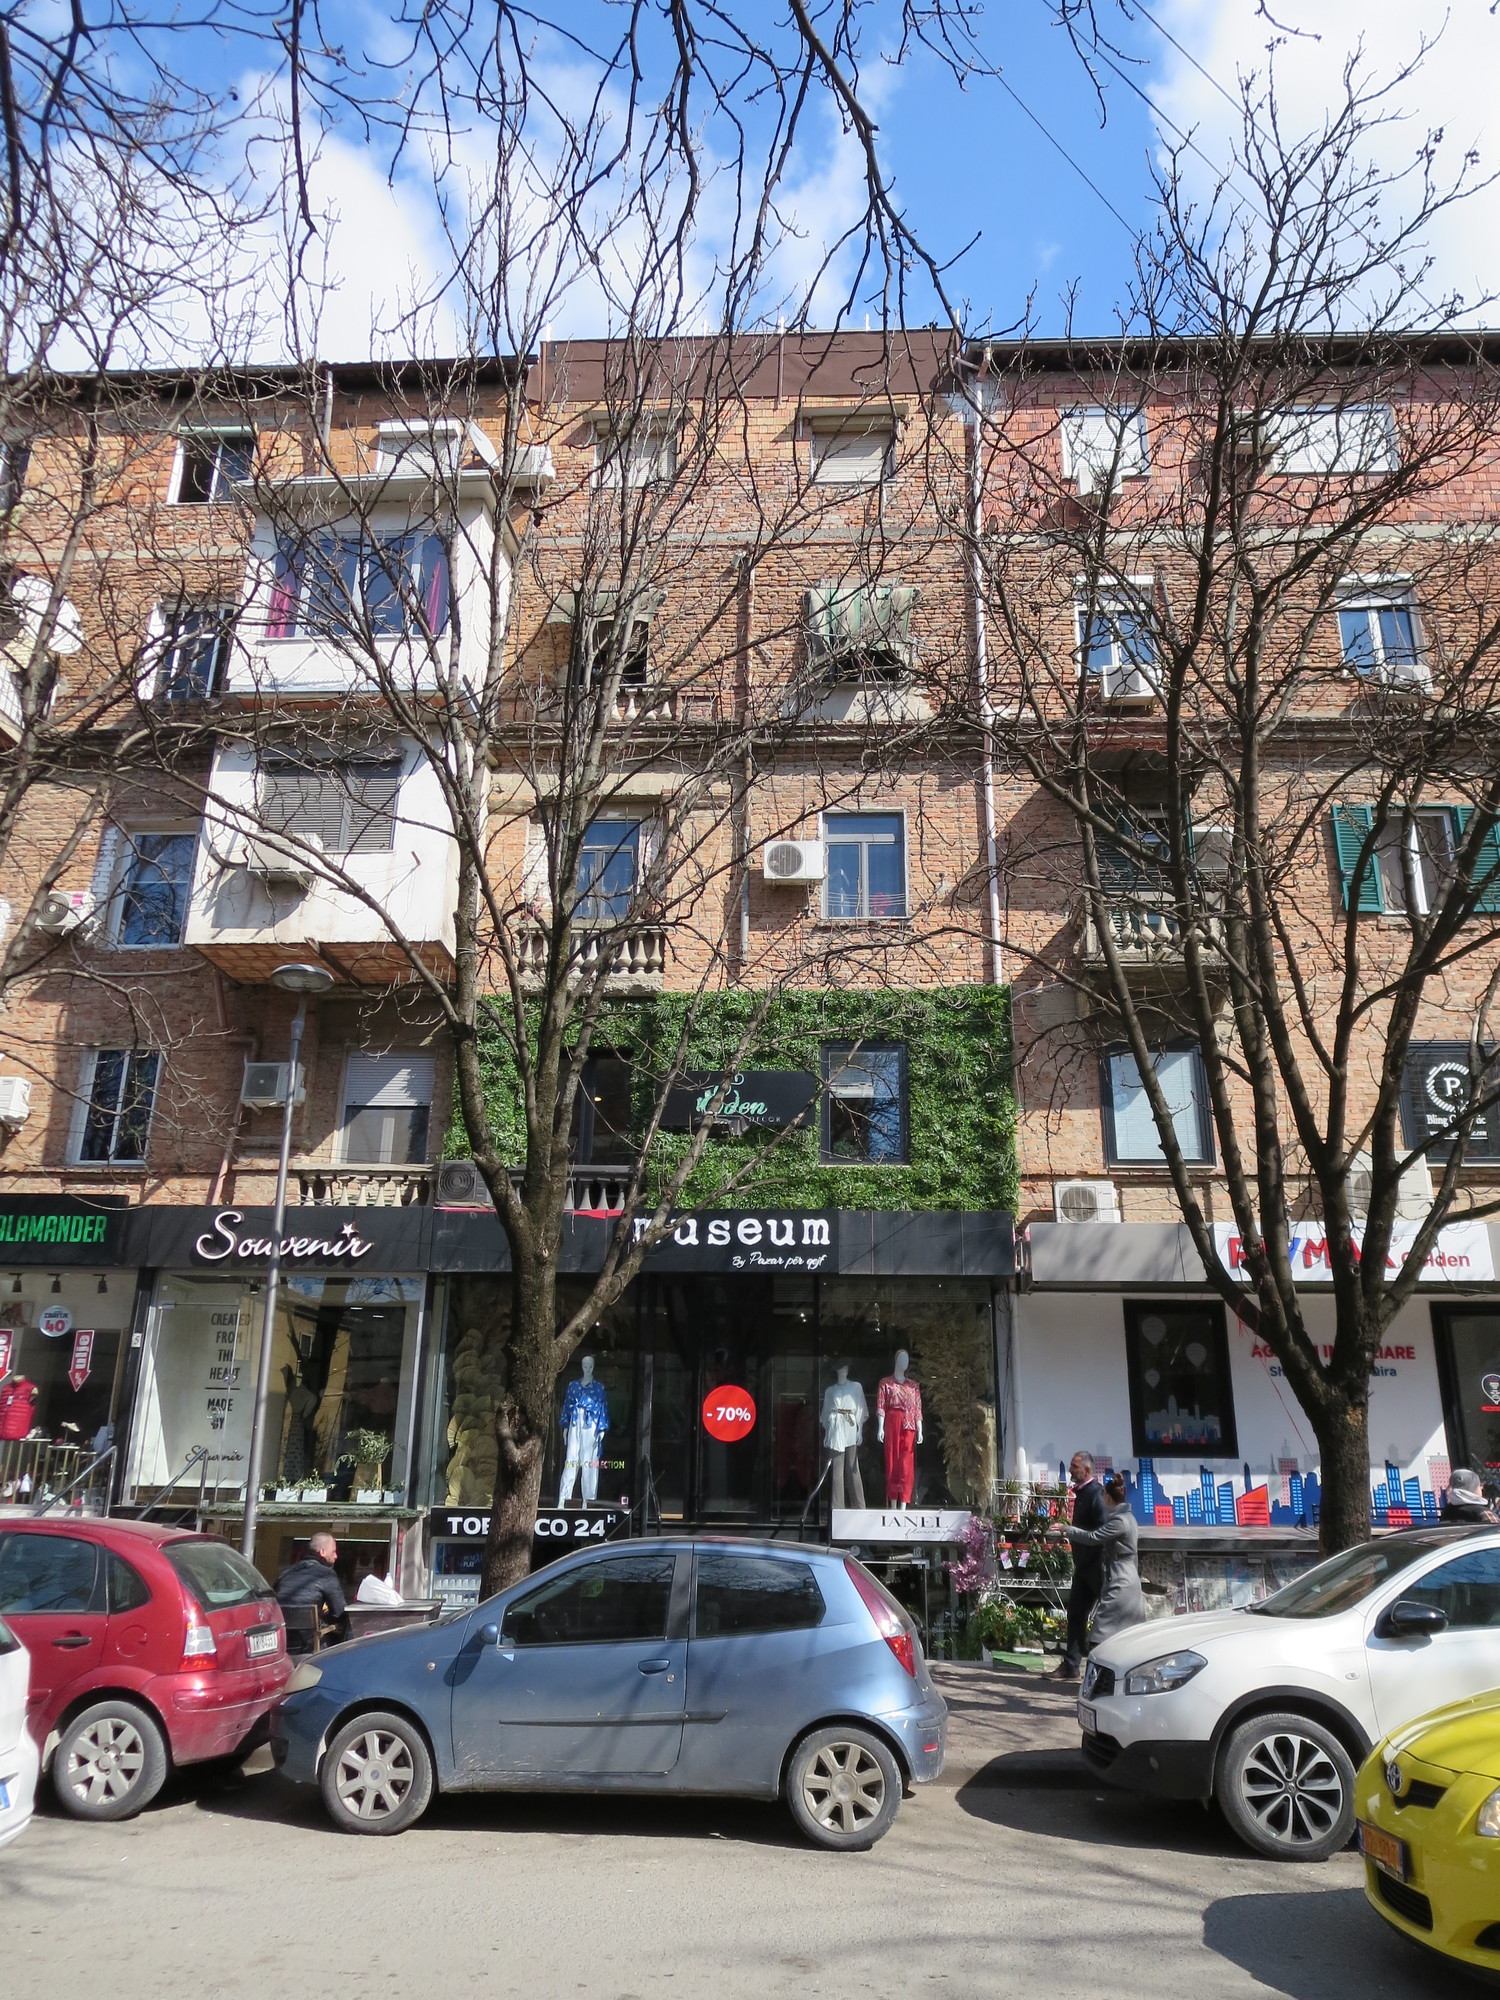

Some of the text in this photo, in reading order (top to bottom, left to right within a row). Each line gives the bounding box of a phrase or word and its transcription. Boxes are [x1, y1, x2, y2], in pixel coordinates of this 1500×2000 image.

[1426, 1114, 1449, 1128] Bling
[196, 1210, 374, 1260] Souvenir
[732, 1255, 745, 1269] By
[749, 1251, 784, 1266] Pazar
[784, 1255, 804, 1269] për
[1401, 1251, 1471, 1268] lden
[211, 1313, 251, 1326] CREATED
[447, 1516, 568, 1537] TOCO
